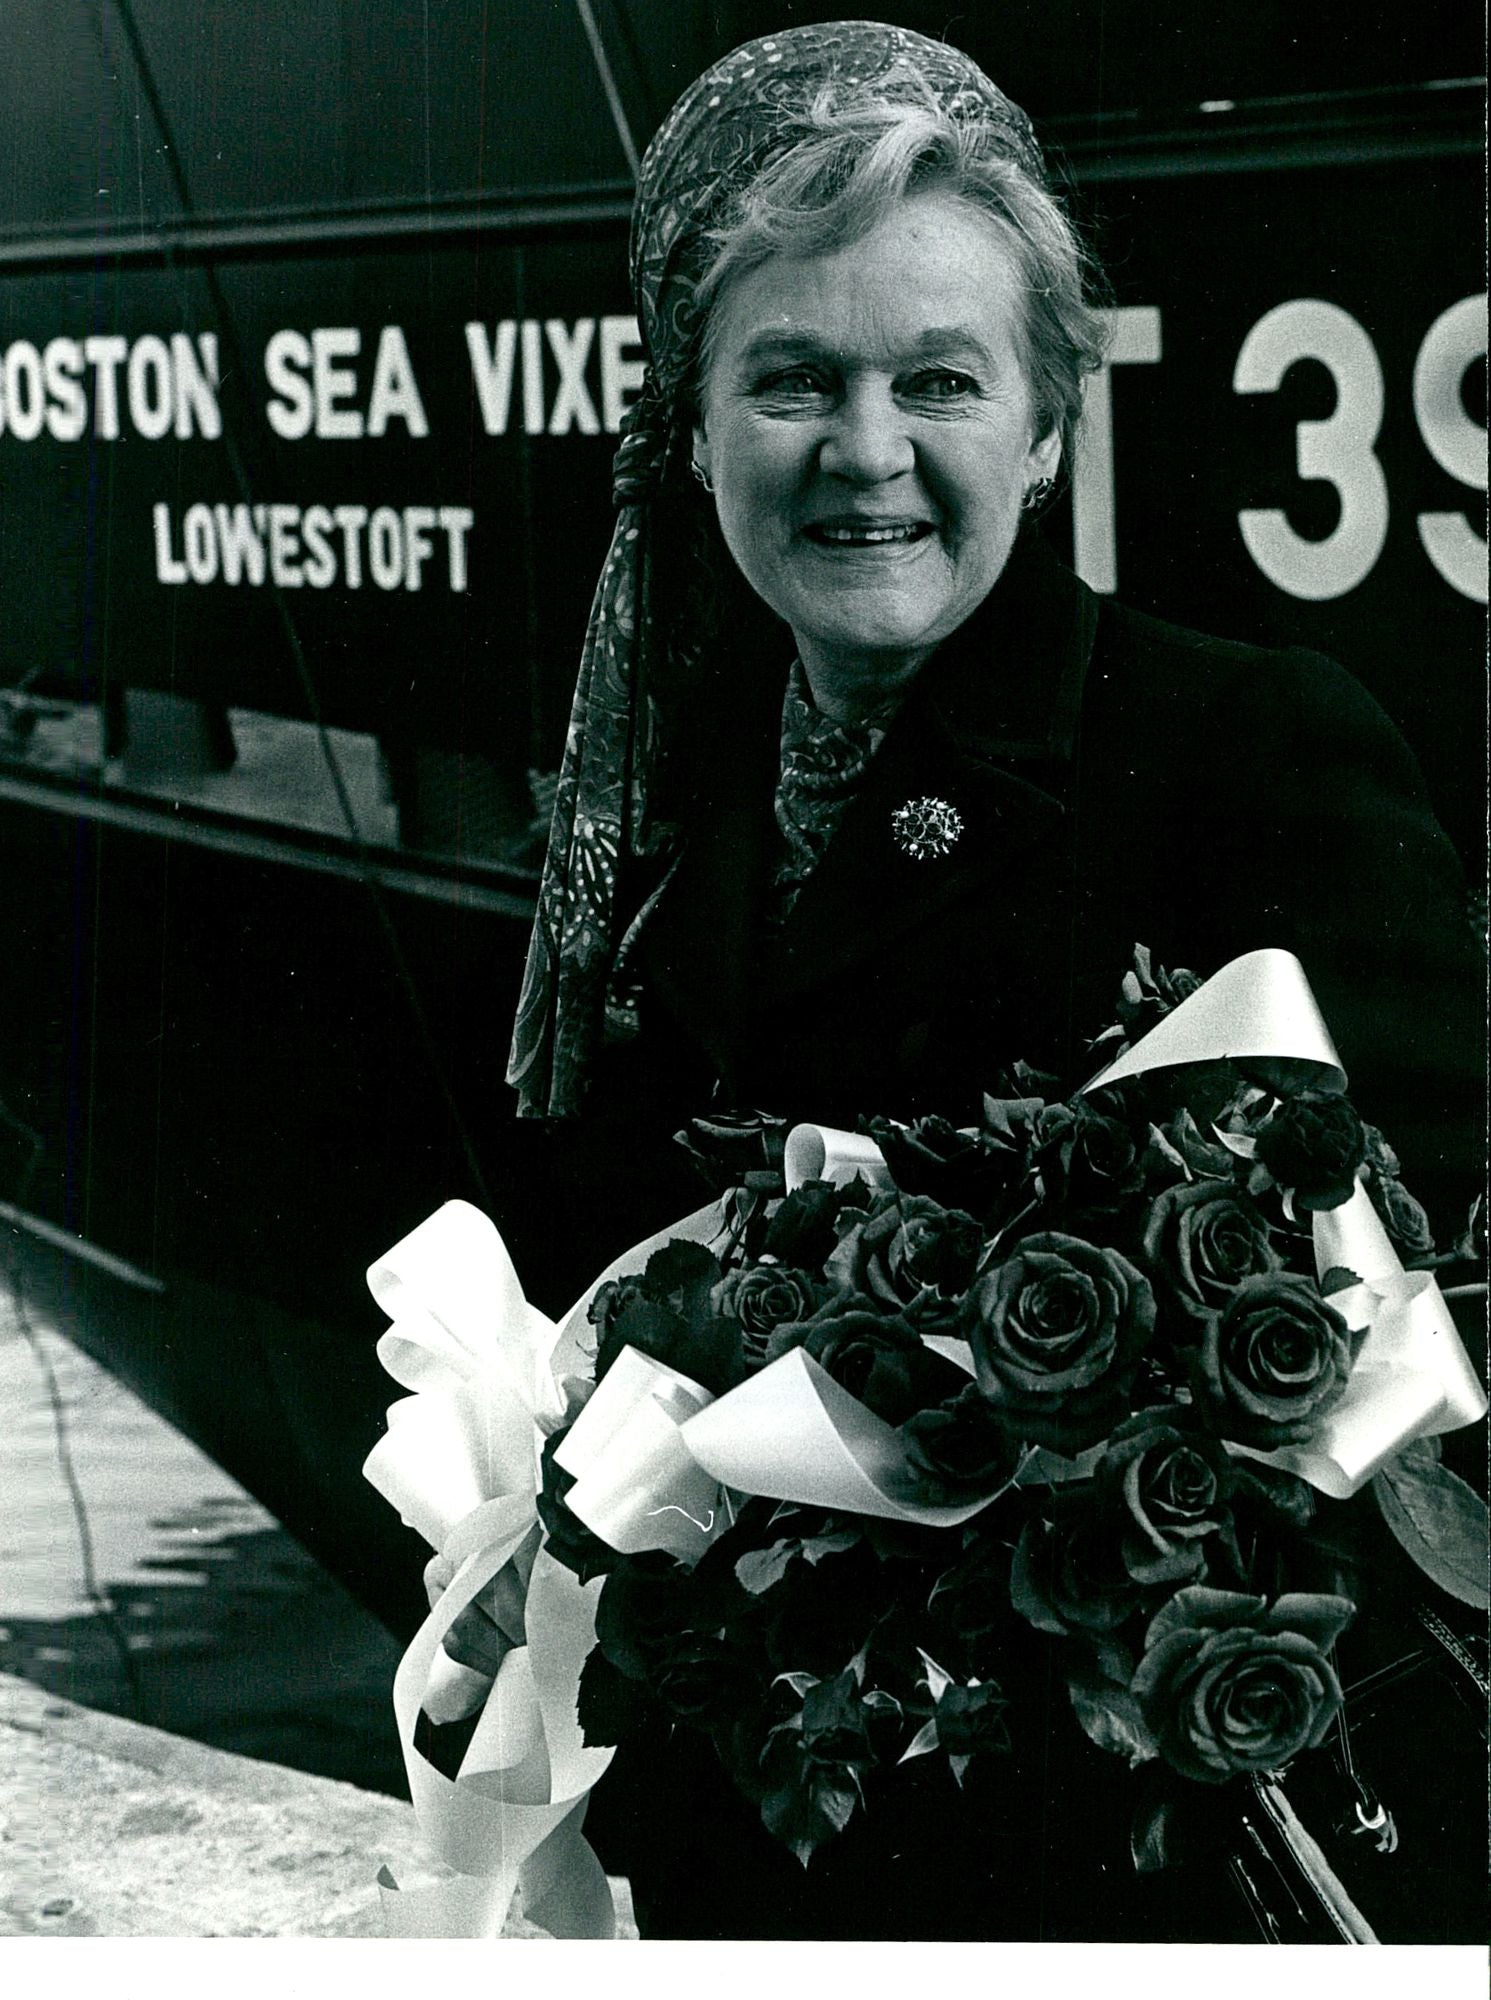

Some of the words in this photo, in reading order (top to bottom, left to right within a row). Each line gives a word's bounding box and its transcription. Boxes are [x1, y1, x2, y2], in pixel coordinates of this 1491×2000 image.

[0, 332, 222, 442] OSTON
[264, 325, 429, 440] SEA
[464, 315, 650, 436] VIXE
[153, 502, 474, 592] LOWESTOFT
